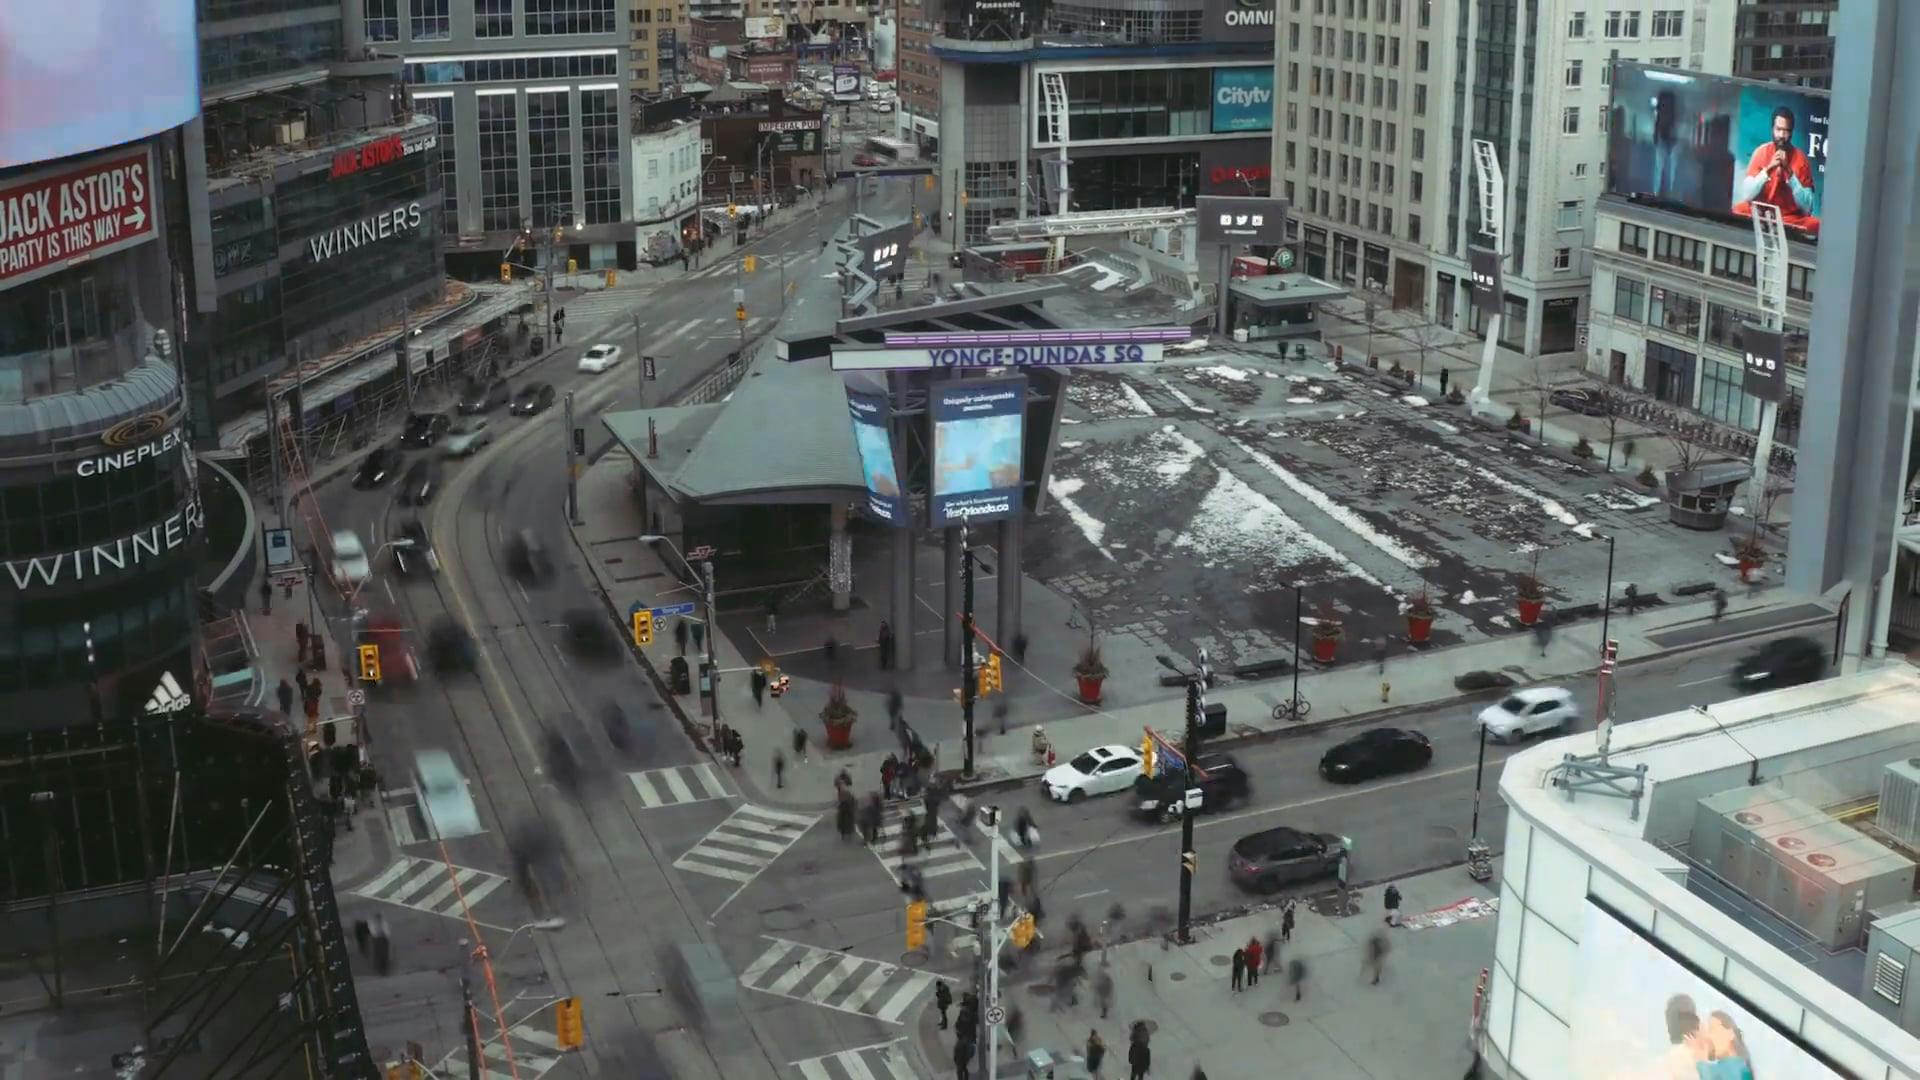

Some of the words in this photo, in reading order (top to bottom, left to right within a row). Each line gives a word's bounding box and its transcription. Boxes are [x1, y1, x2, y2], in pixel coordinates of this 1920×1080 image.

[975, 1, 1020, 9] Panasonic
[1225, 10, 1274, 26] OMNI
[1217, 86, 1271, 107] Citytv
[802, 120, 820, 129] PUB
[0, 187, 54, 242] JACK
[60, 163, 144, 225] ASTOR'S
[0, 237, 43, 274] PARTY
[47, 232, 60, 259] IS
[62, 222, 92, 253] THIS
[94, 212, 121, 243] WAY
[310, 202, 421, 263] WINNERS
[928, 346, 1106, 367] YONGE-DUNDAS
[1114, 344, 1144, 363] SQ
[77, 427, 182, 477] CINEPLEX
